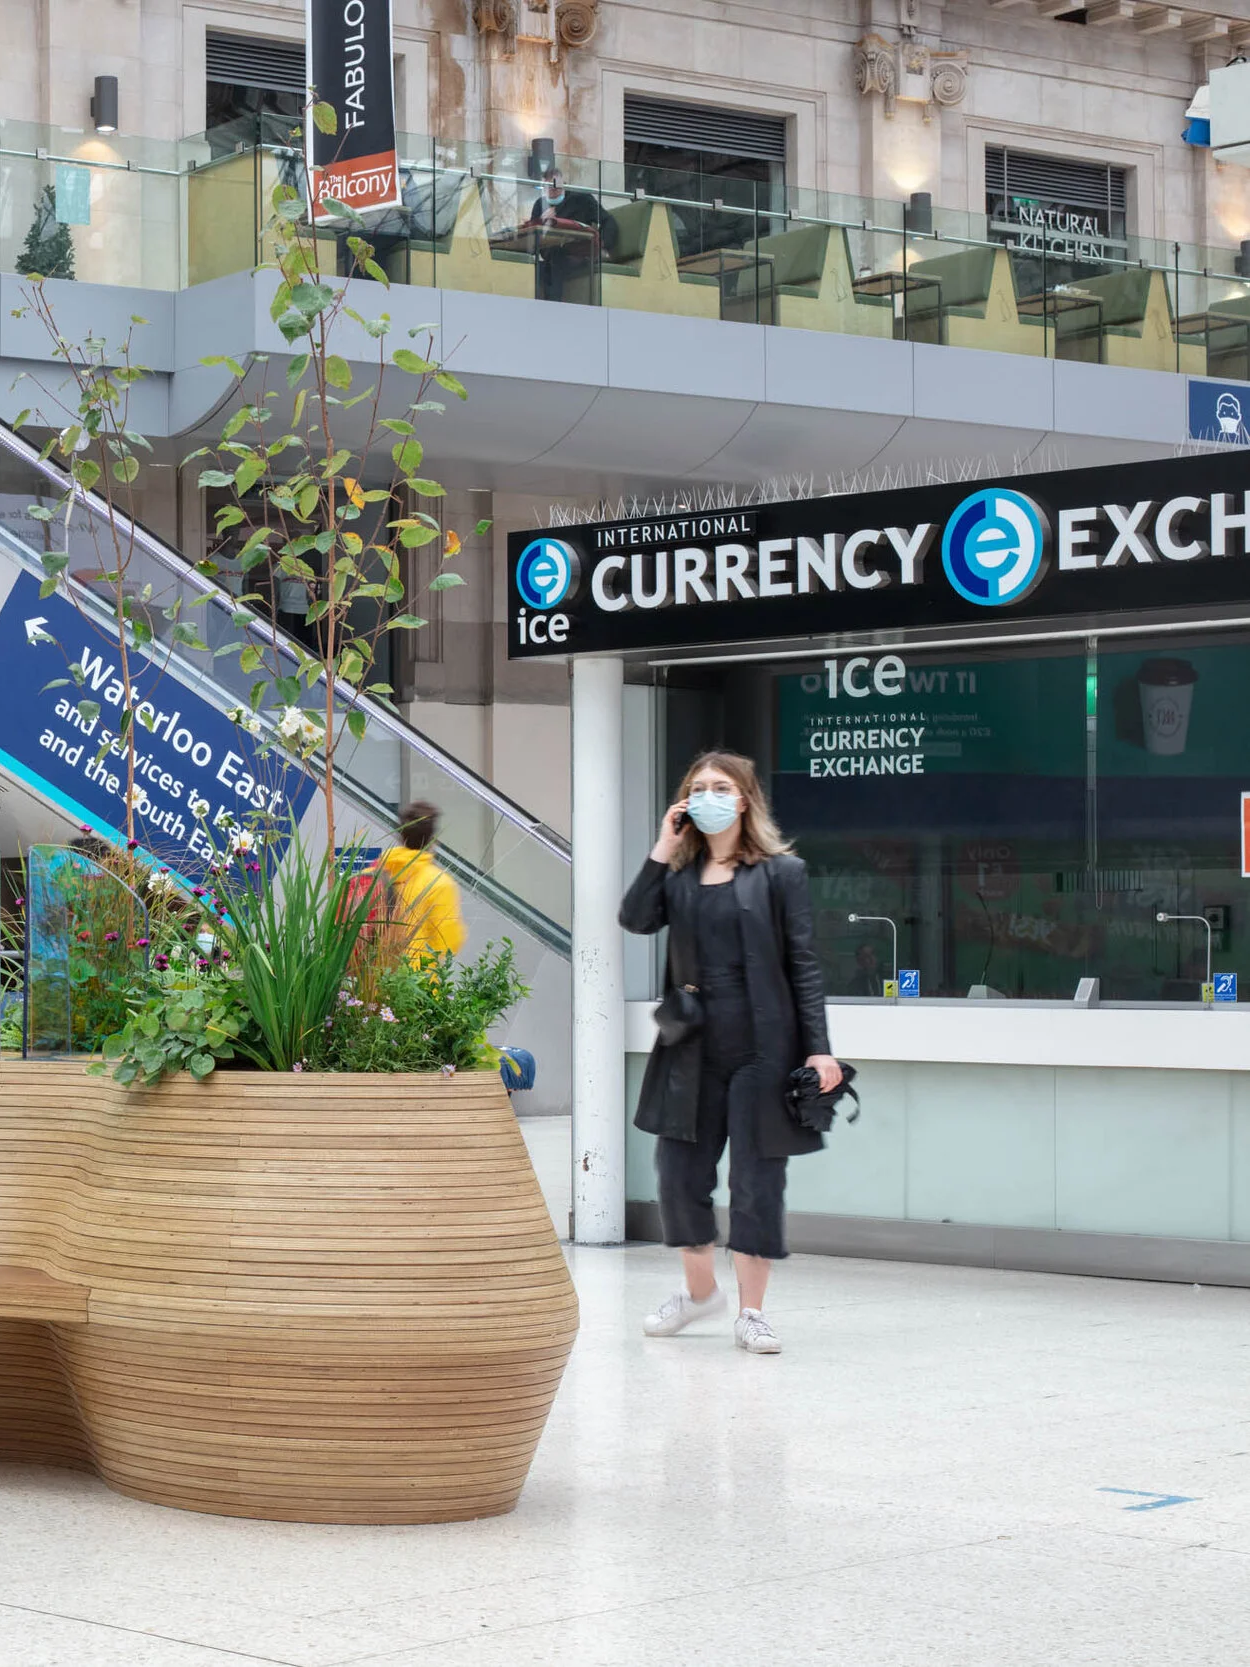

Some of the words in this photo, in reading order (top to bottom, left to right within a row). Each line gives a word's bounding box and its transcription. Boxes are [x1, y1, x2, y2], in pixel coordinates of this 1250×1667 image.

[344, 0, 365, 130] FABULO
[318, 171, 393, 203] Balcony
[329, 174, 343, 184] The
[1018, 206, 1104, 238] NATURAL
[597, 515, 751, 548] INTERNATIONAL
[1058, 491, 1250, 571] EXCH
[591, 522, 935, 612] CURRENCY
[517, 608, 570, 645] ice
[824, 655, 907, 699] ice
[80, 645, 212, 767] Waterloo
[215, 750, 284, 818] East
[810, 712, 926, 726] INTERNATIONAL
[810, 727, 926, 752] CURRENCY
[97, 729, 184, 798] services
[810, 754, 925, 778] EXCHANGE
[39, 728, 84, 767] and
[84, 756, 120, 795] the
[124, 784, 186, 841] outh
